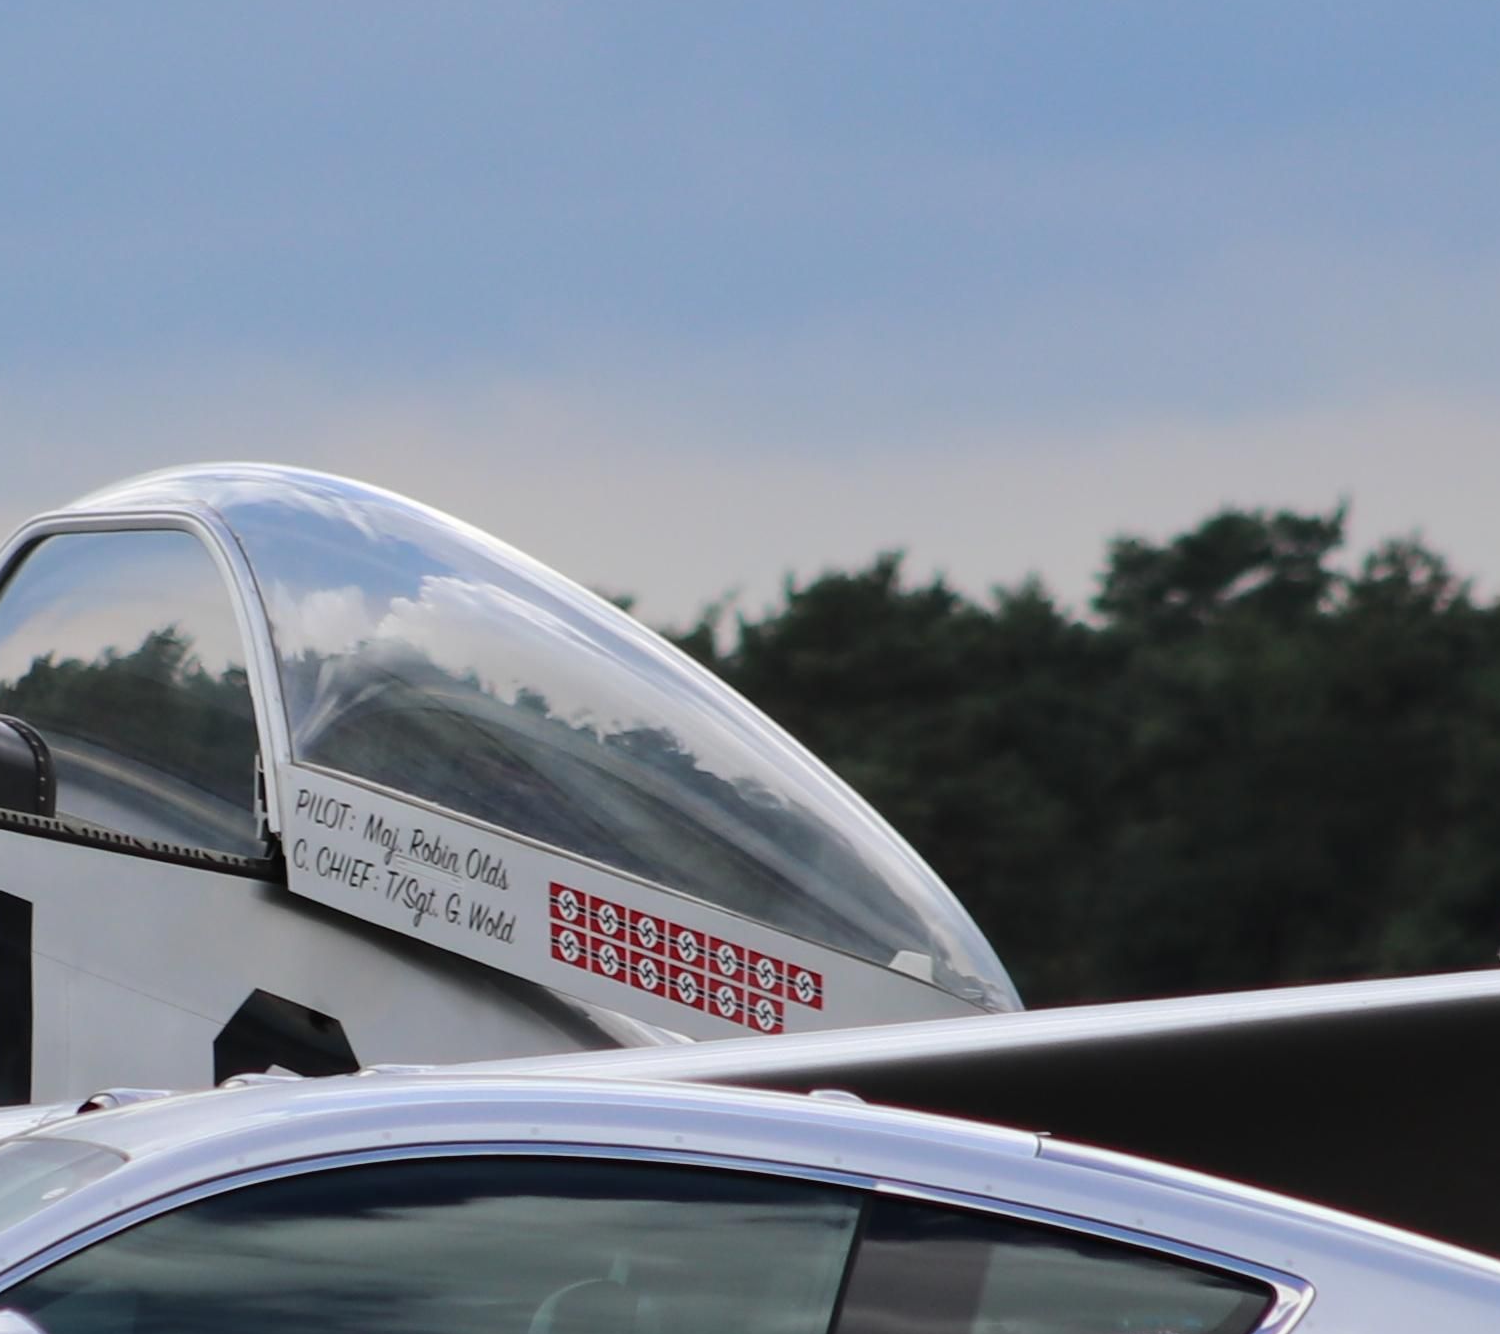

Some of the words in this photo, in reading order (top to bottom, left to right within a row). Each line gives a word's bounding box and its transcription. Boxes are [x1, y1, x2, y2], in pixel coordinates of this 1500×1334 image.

[293, 838, 309, 872] C.
[445, 893, 462, 925] G.
[469, 901, 517, 945] Wold
[295, 789, 356, 831] PILOT:
[363, 814, 403, 866] Maj.
[409, 829, 460, 873] Robin
[465, 848, 510, 891] Olds
